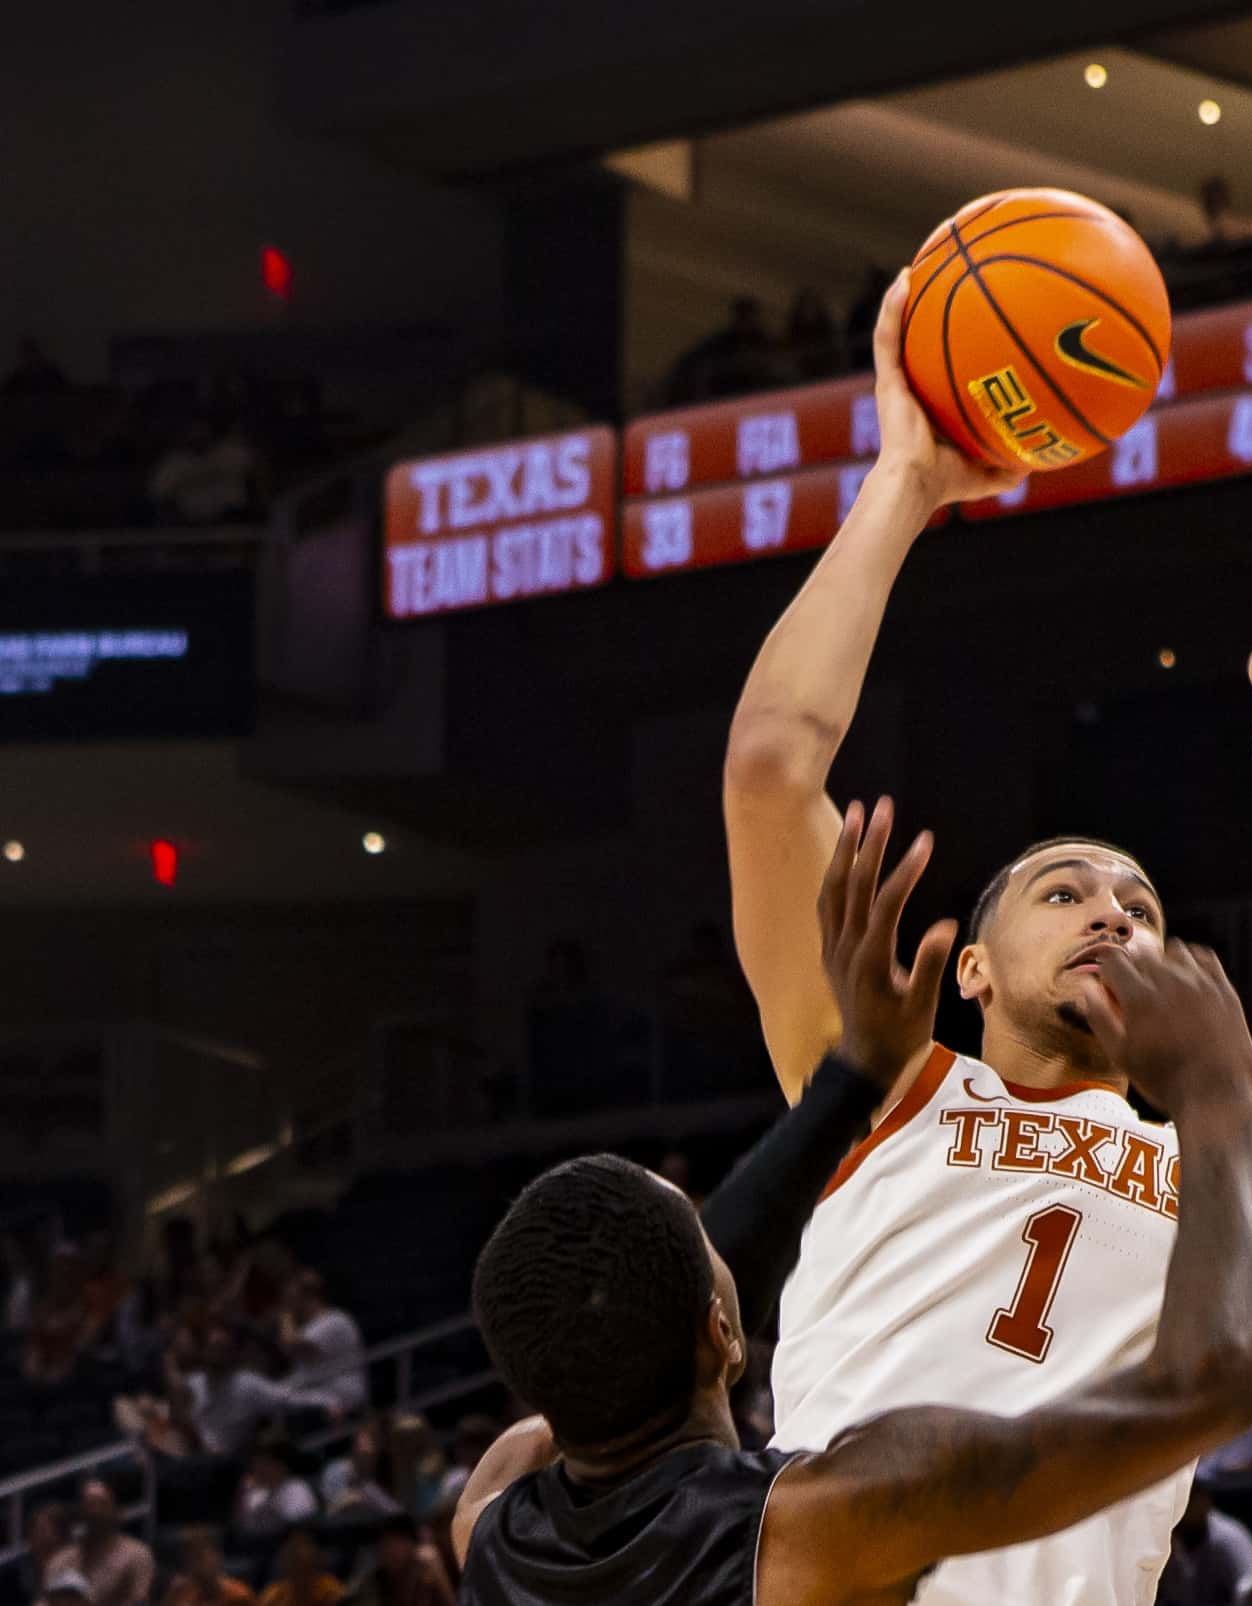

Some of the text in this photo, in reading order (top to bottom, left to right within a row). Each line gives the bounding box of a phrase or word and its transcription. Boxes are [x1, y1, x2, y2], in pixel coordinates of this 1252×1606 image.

[410, 434, 592, 536] TEXAS
[644, 431, 690, 493] FG
[737, 411, 799, 476] FGA
[388, 513, 604, 616] TEAM STATS
[642, 501, 692, 569] 33
[743, 480, 792, 550] 57
[985, 1202, 1083, 1364] 1
